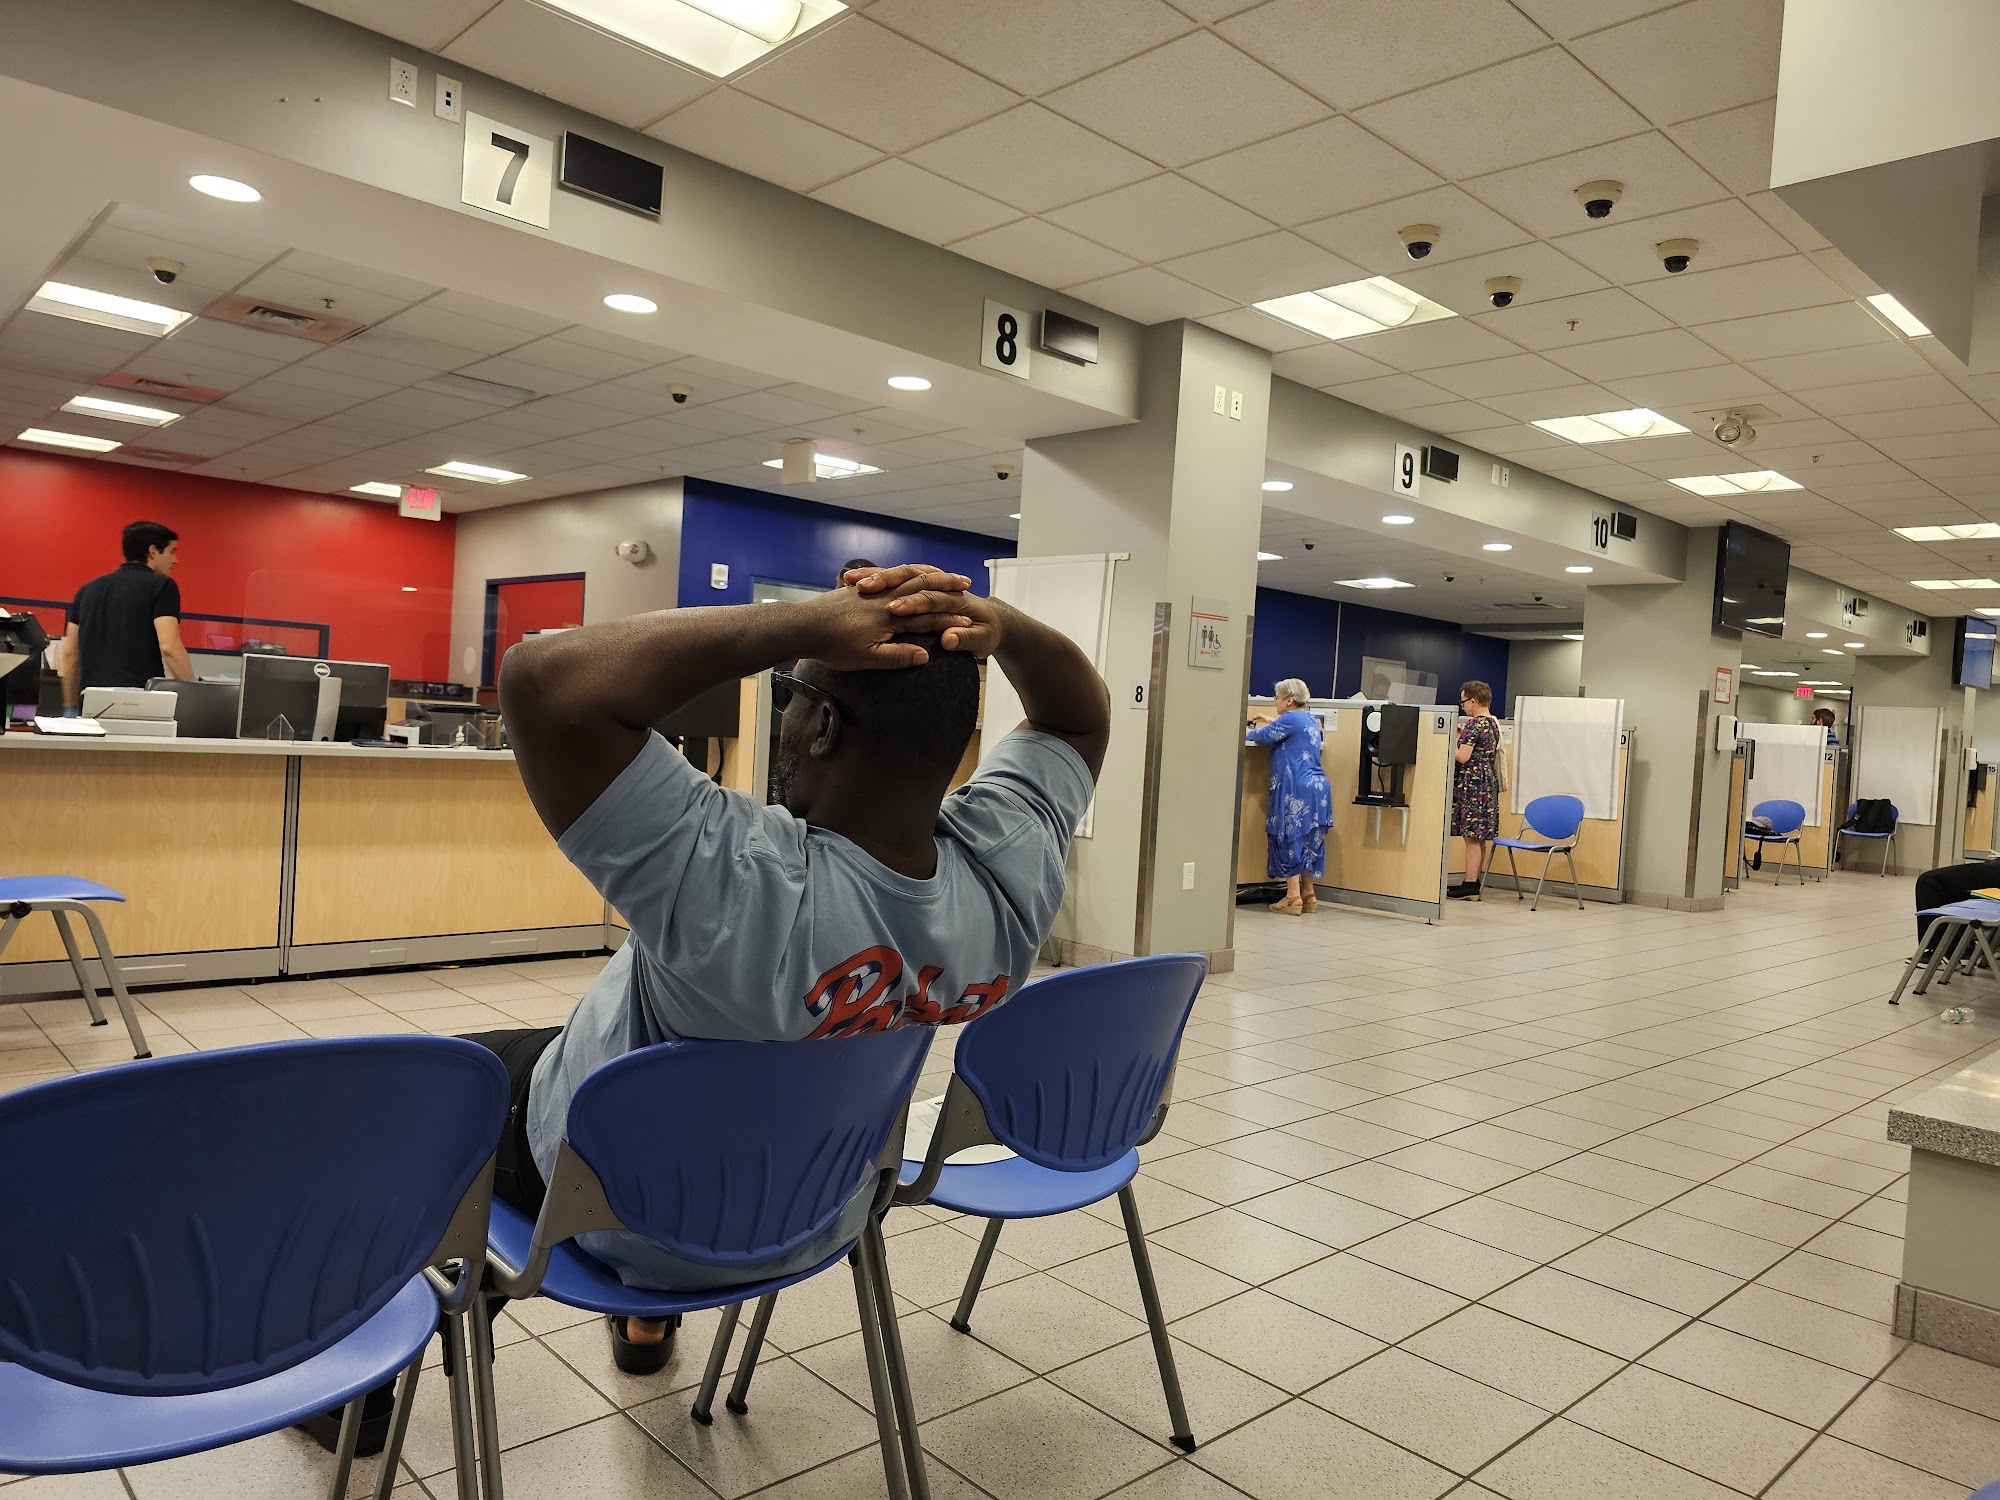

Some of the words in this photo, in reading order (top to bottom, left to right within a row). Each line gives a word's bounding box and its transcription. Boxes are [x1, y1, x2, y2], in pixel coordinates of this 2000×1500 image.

[491, 132, 530, 206] 7
[995, 313, 1018, 366] 8
[1402, 452, 1414, 489] 9
[1593, 516, 1608, 549] 10
[1906, 623, 1913, 644] 13
[1135, 685, 1144, 703] 8
[1437, 716, 1445, 729] 9
